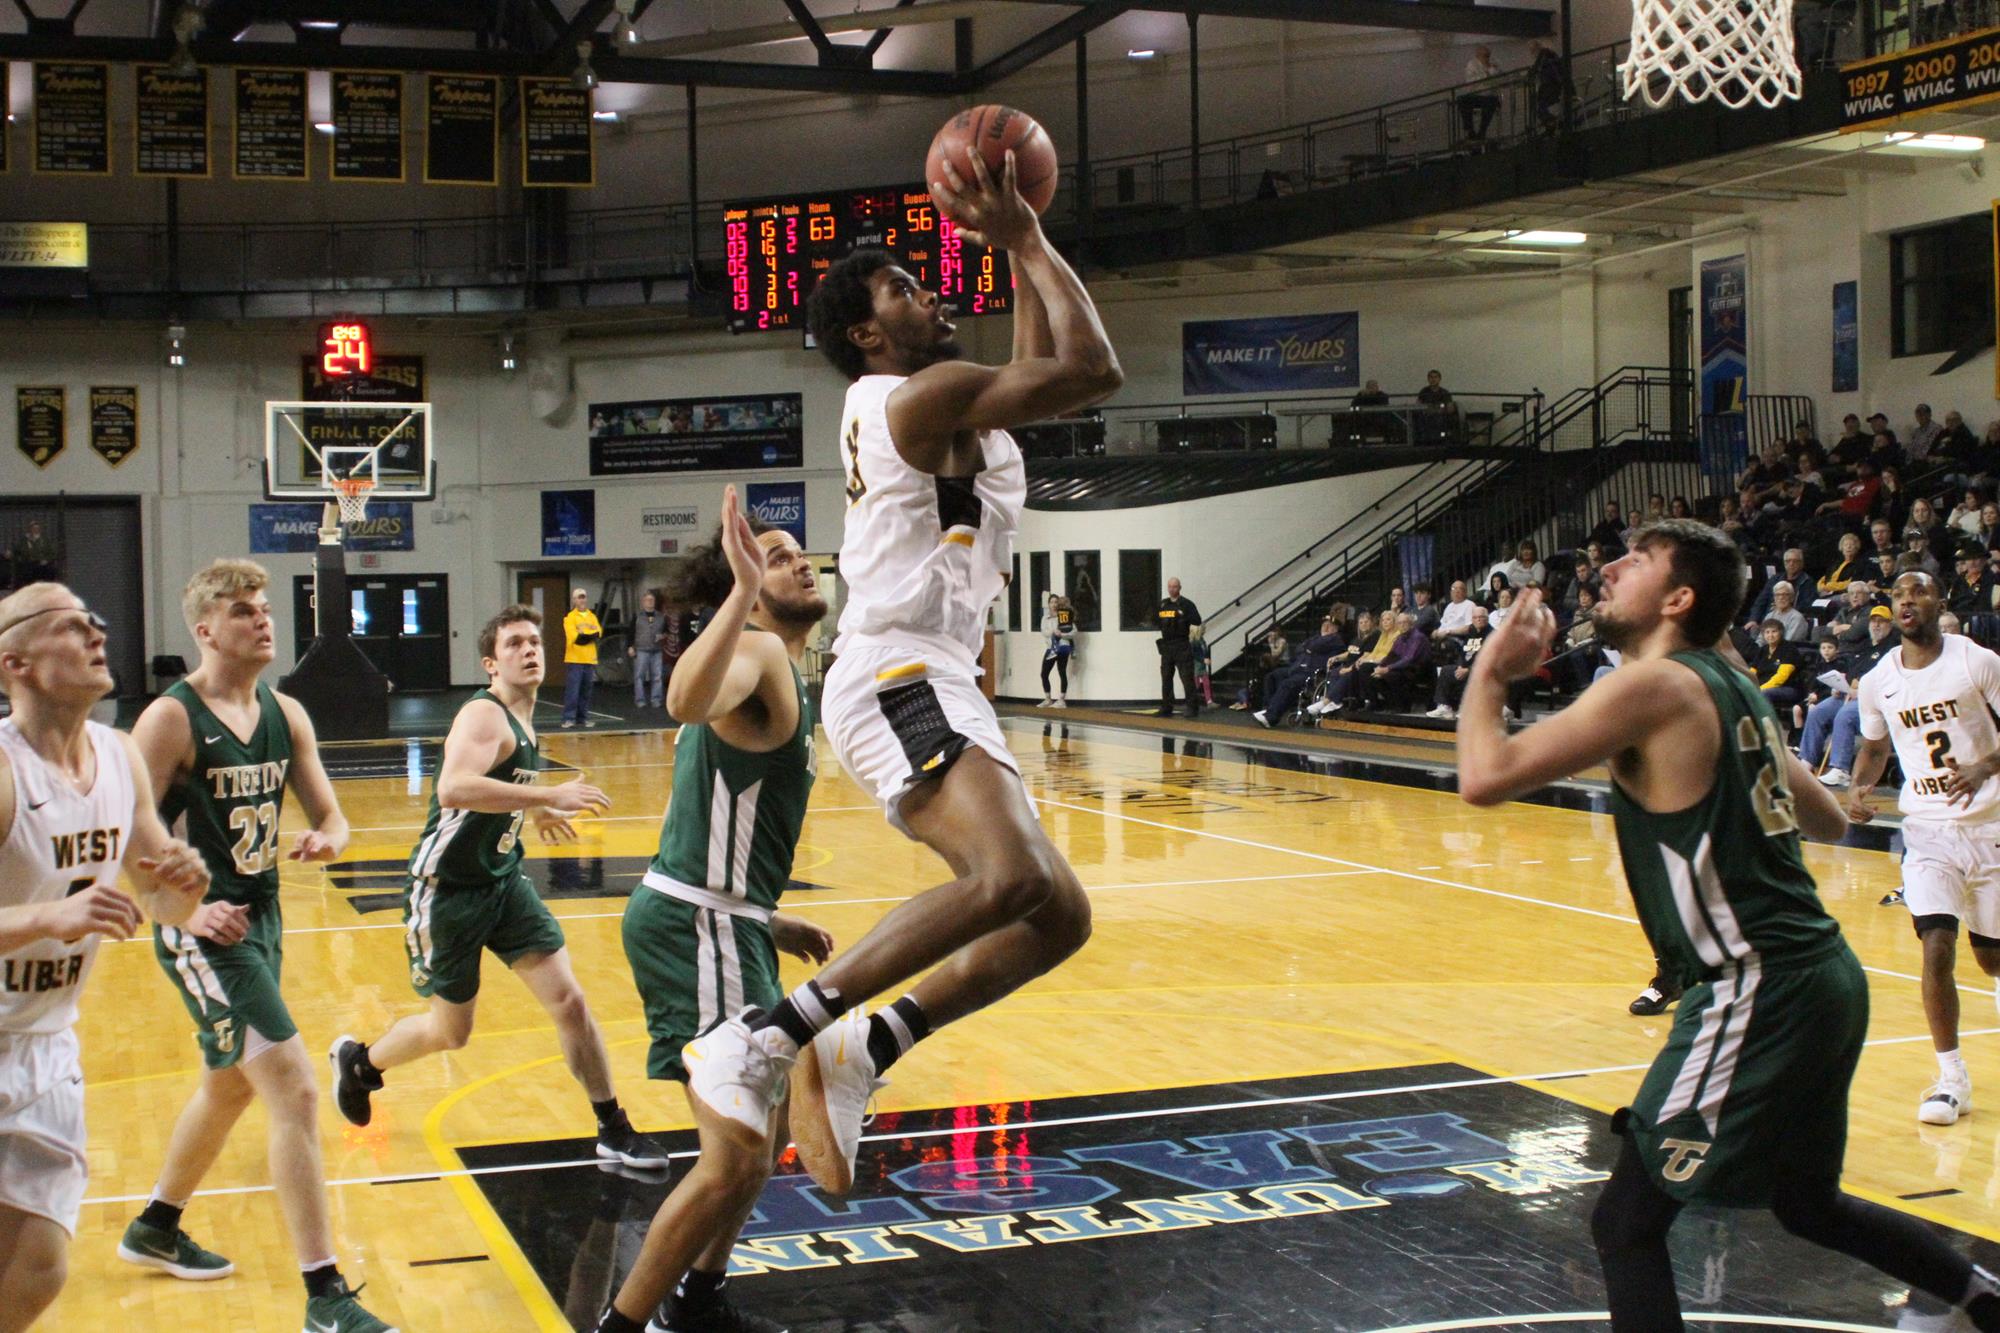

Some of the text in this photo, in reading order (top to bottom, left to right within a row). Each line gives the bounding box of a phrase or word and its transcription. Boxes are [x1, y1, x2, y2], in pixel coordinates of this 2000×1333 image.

[1847, 70, 1890, 97] 1997
[1903, 54, 1956, 84] 2000
[434, 84, 492, 103] Toppers
[529, 89, 585, 107] Toppers
[1845, 94, 1894, 117] WVIAC
[1903, 78, 1956, 103] WVIAC
[809, 203, 831, 214] Home
[904, 193, 931, 204] Guests
[727, 217, 797, 240] 02 15 2
[810, 207, 933, 241] 63 56
[727, 236, 797, 258] 03 16 2
[886, 228, 896, 245] 2
[940, 239, 961, 257] 22
[728, 257, 776, 276] 05 4
[940, 255, 993, 277] 04 0
[734, 275, 749, 293] 10
[767, 274, 777, 291] 3
[787, 271, 798, 289] 2
[941, 277, 962, 295] 21
[977, 274, 993, 292] 13
[767, 291, 777, 309] 8
[793, 291, 798, 305] 1
[973, 294, 984, 312] 2
[758, 310, 769, 328] 2
[324, 340, 365, 372] 24
[1207, 334, 1345, 368] MAKE IT YOURS
[751, 500, 799, 522] YOURS
[769, 496, 791, 505] MAKE
[272, 515, 402, 535] MAKE OURS
[643, 512, 696, 526] RESTROOMS
[1898, 699, 1959, 729] WEST
[1925, 730, 1957, 770] 2
[207, 759, 289, 799] TIFFIN
[51, 827, 120, 869] WEST
[229, 801, 279, 875] 22
